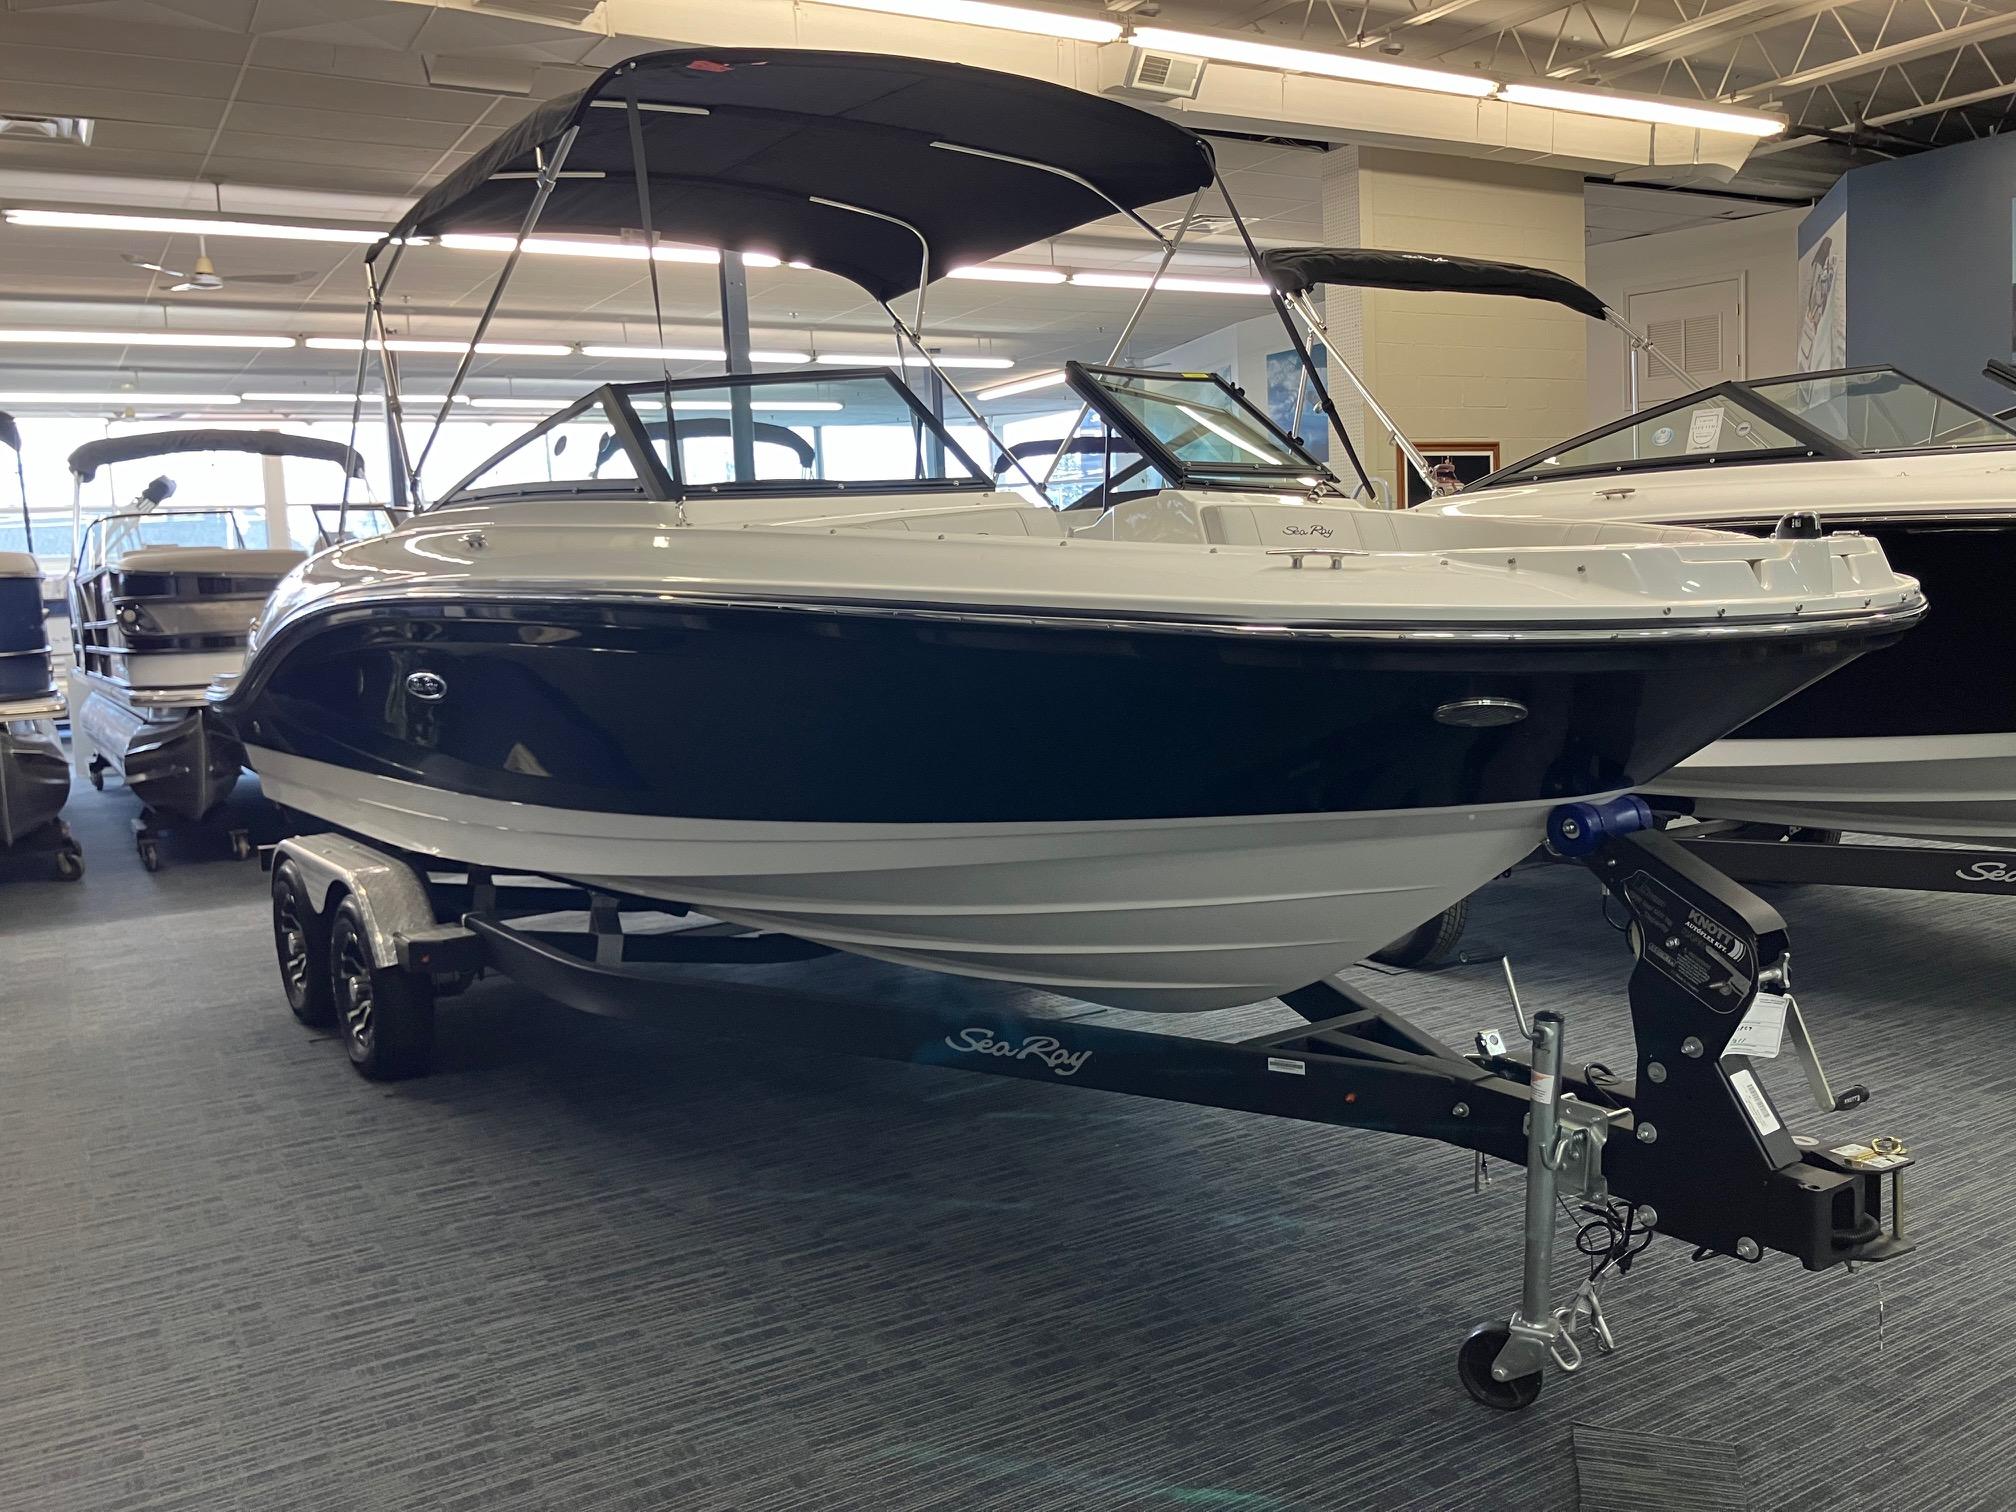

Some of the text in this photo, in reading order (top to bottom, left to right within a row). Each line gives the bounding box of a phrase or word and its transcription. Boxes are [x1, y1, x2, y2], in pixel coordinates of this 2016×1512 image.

[1282, 524, 1334, 538] Sea Ray
[1688, 909, 1734, 945] KNOTT
[944, 1027, 1093, 1076] Sea Ray
